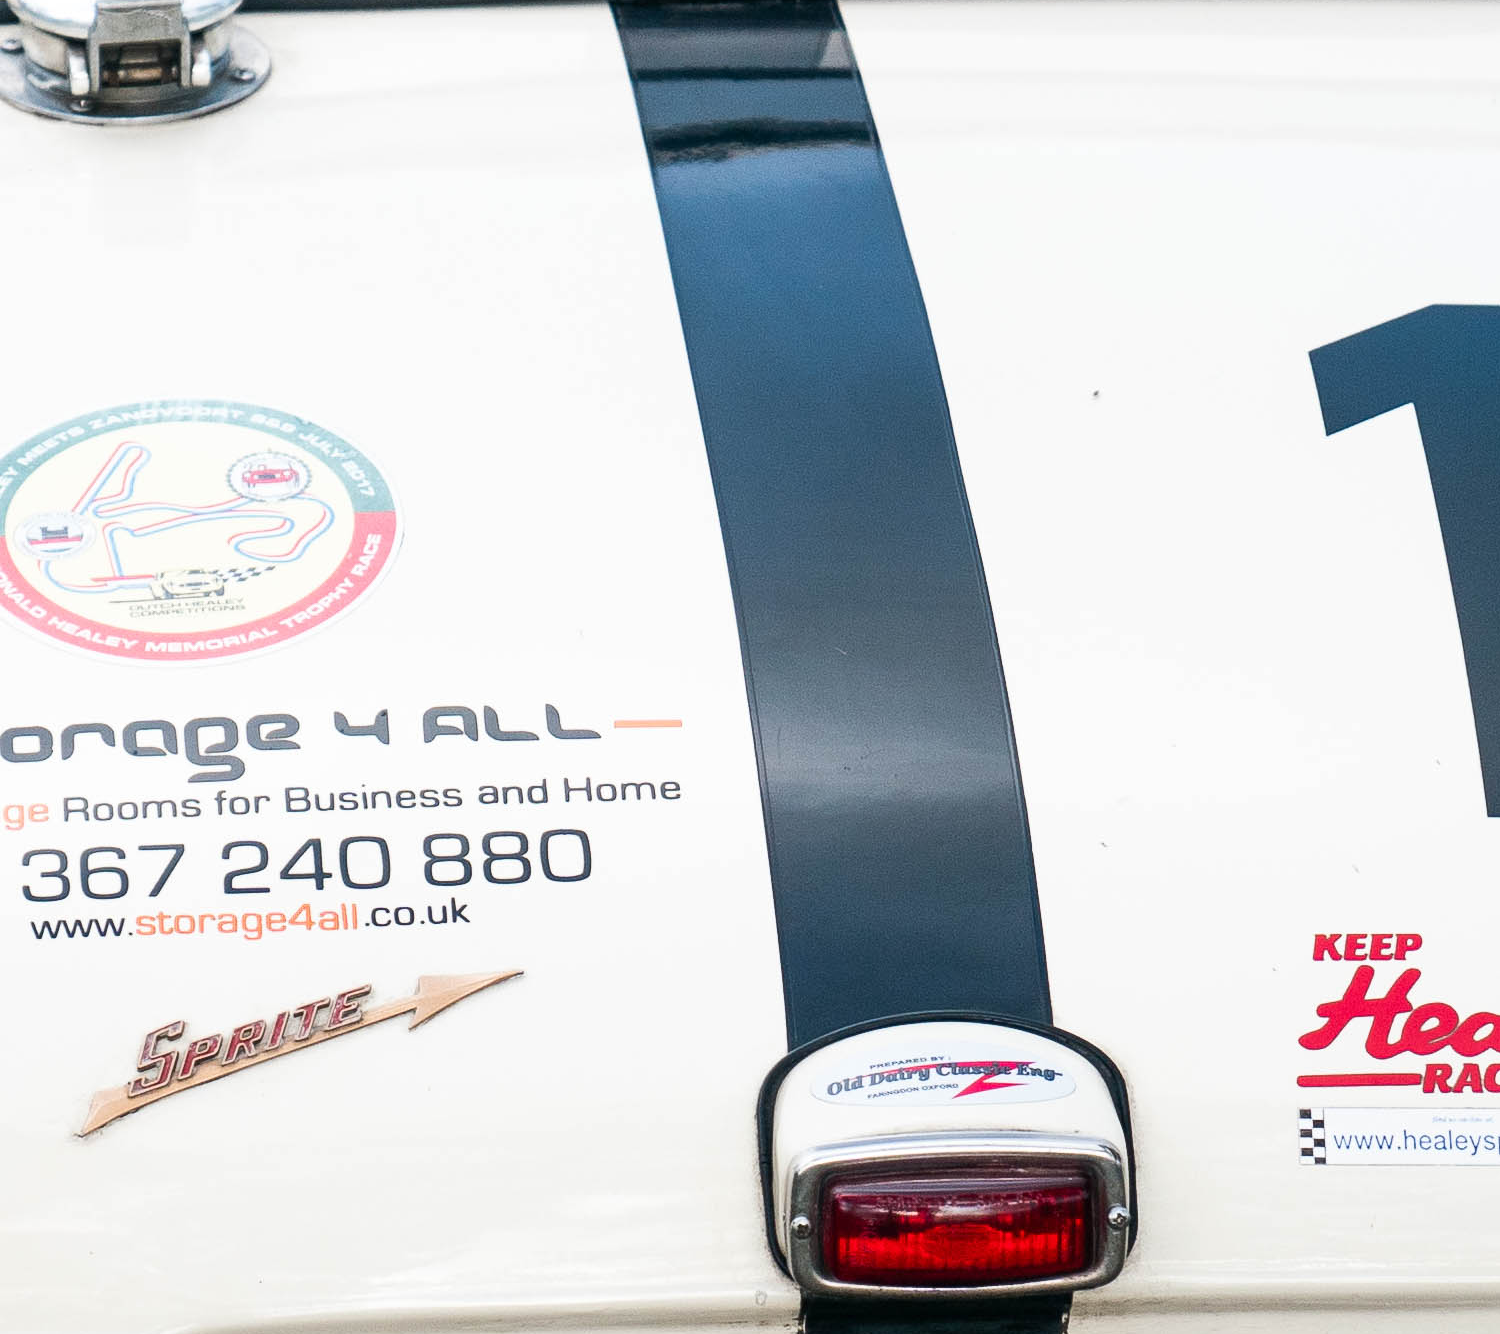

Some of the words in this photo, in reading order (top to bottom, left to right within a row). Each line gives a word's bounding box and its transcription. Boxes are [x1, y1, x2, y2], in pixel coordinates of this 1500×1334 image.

[16, 425, 86, 467] MEETS
[297, 432, 347, 459] JULY
[47, 616, 139, 650] HEALEY
[143, 627, 280, 653] MEMORIAL
[279, 577, 355, 629] TROPHY
[350, 533, 383, 577] RACE
[333, 708, 391, 745] 4
[422, 703, 602, 744] ALL
[62, 796, 202, 822] Rooms
[214, 789, 271, 816] for
[284, 783, 464, 814] Business
[477, 777, 549, 806] and
[563, 776, 682, 804] Home
[221, 834, 392, 895] 240
[422, 828, 593, 887] 880
[29, 896, 472, 942] www.storage4all.co.uk
[1312, 933, 1423, 962] KEEP
[826, 1073, 864, 1096] Old
[869, 1067, 931, 1087] Dairy
[935, 1061, 1012, 1077] Classic
[869, 1057, 928, 1069] PREPARED
[867, 1087, 920, 1099] FARINGDON
[921, 1083, 959, 1091] OXFORD
